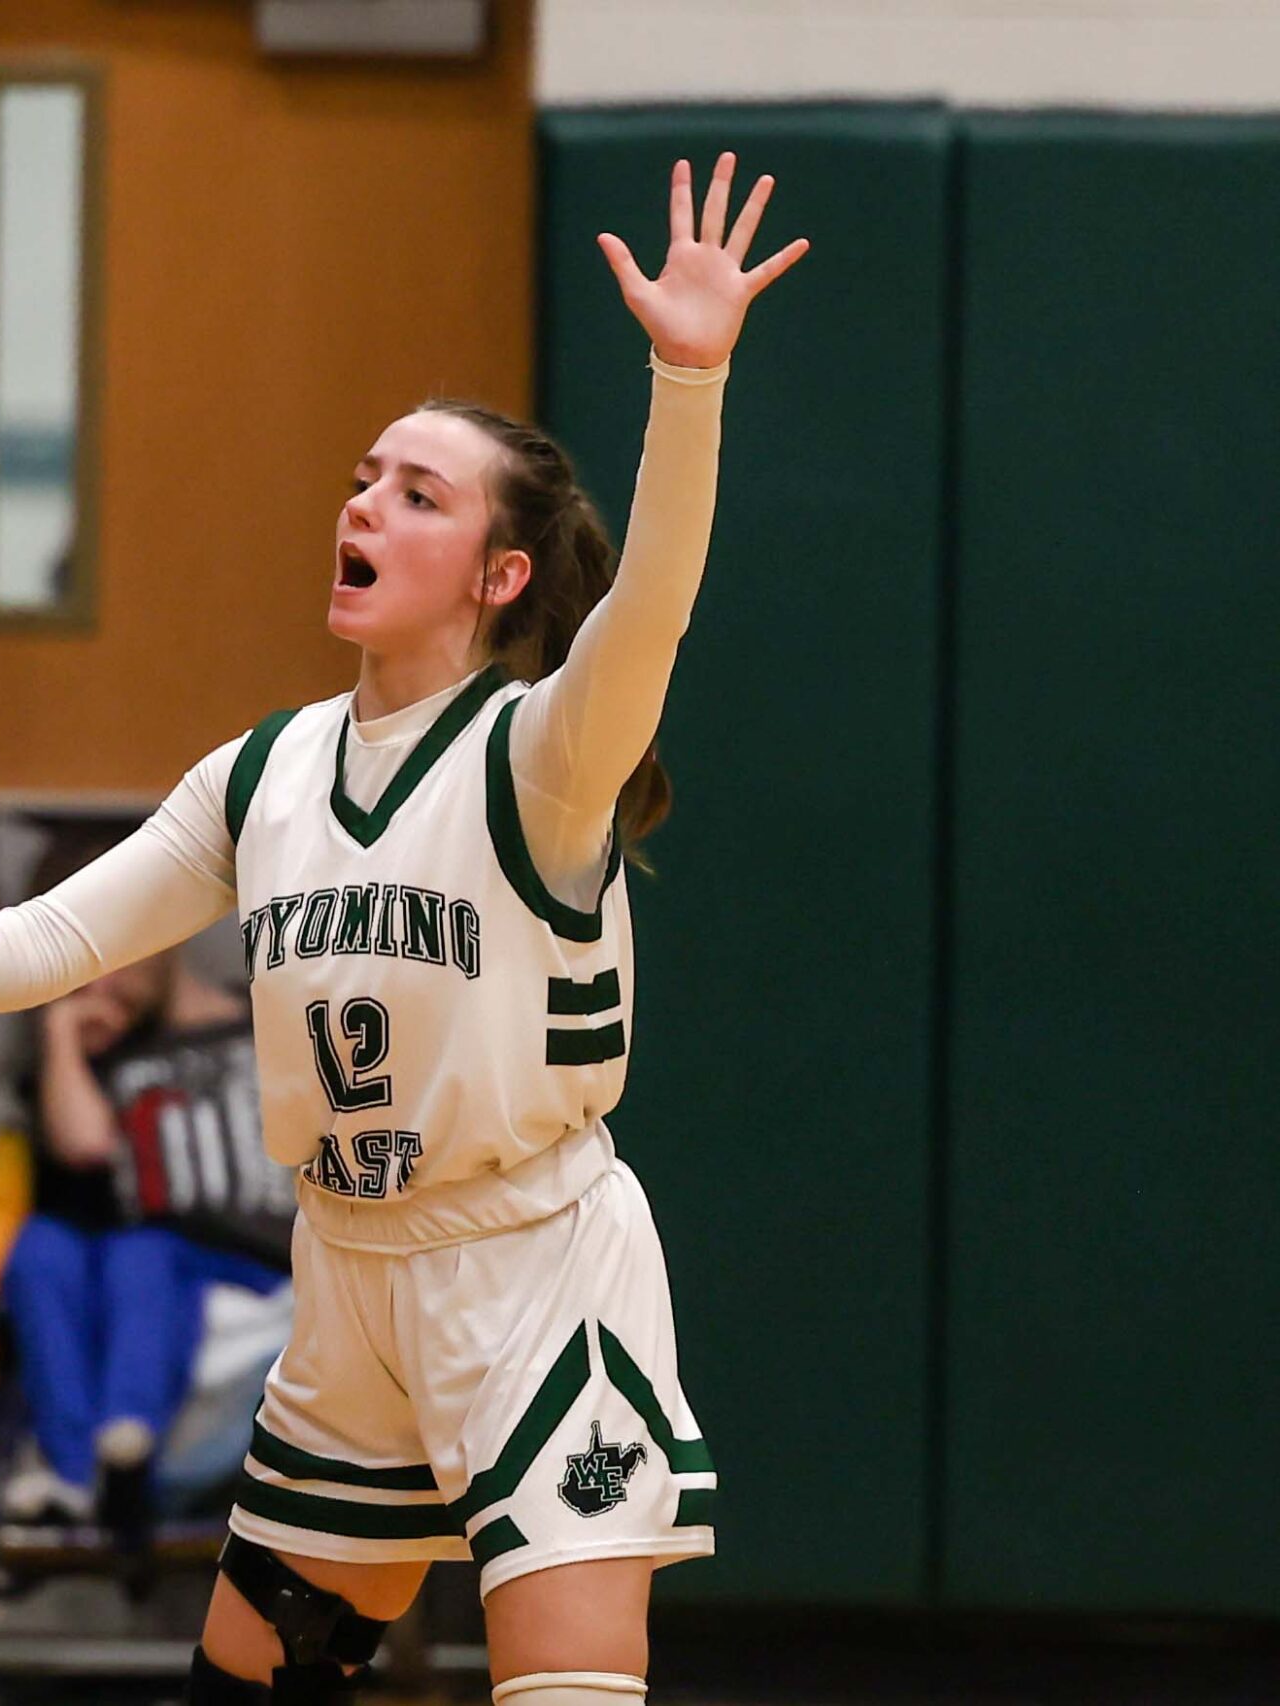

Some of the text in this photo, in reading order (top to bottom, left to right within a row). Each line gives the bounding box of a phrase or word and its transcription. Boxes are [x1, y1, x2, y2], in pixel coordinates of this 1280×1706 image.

[306, 997, 391, 1113] 12
[303, 1130, 423, 1199] AST
[567, 1453, 627, 1501] WE
